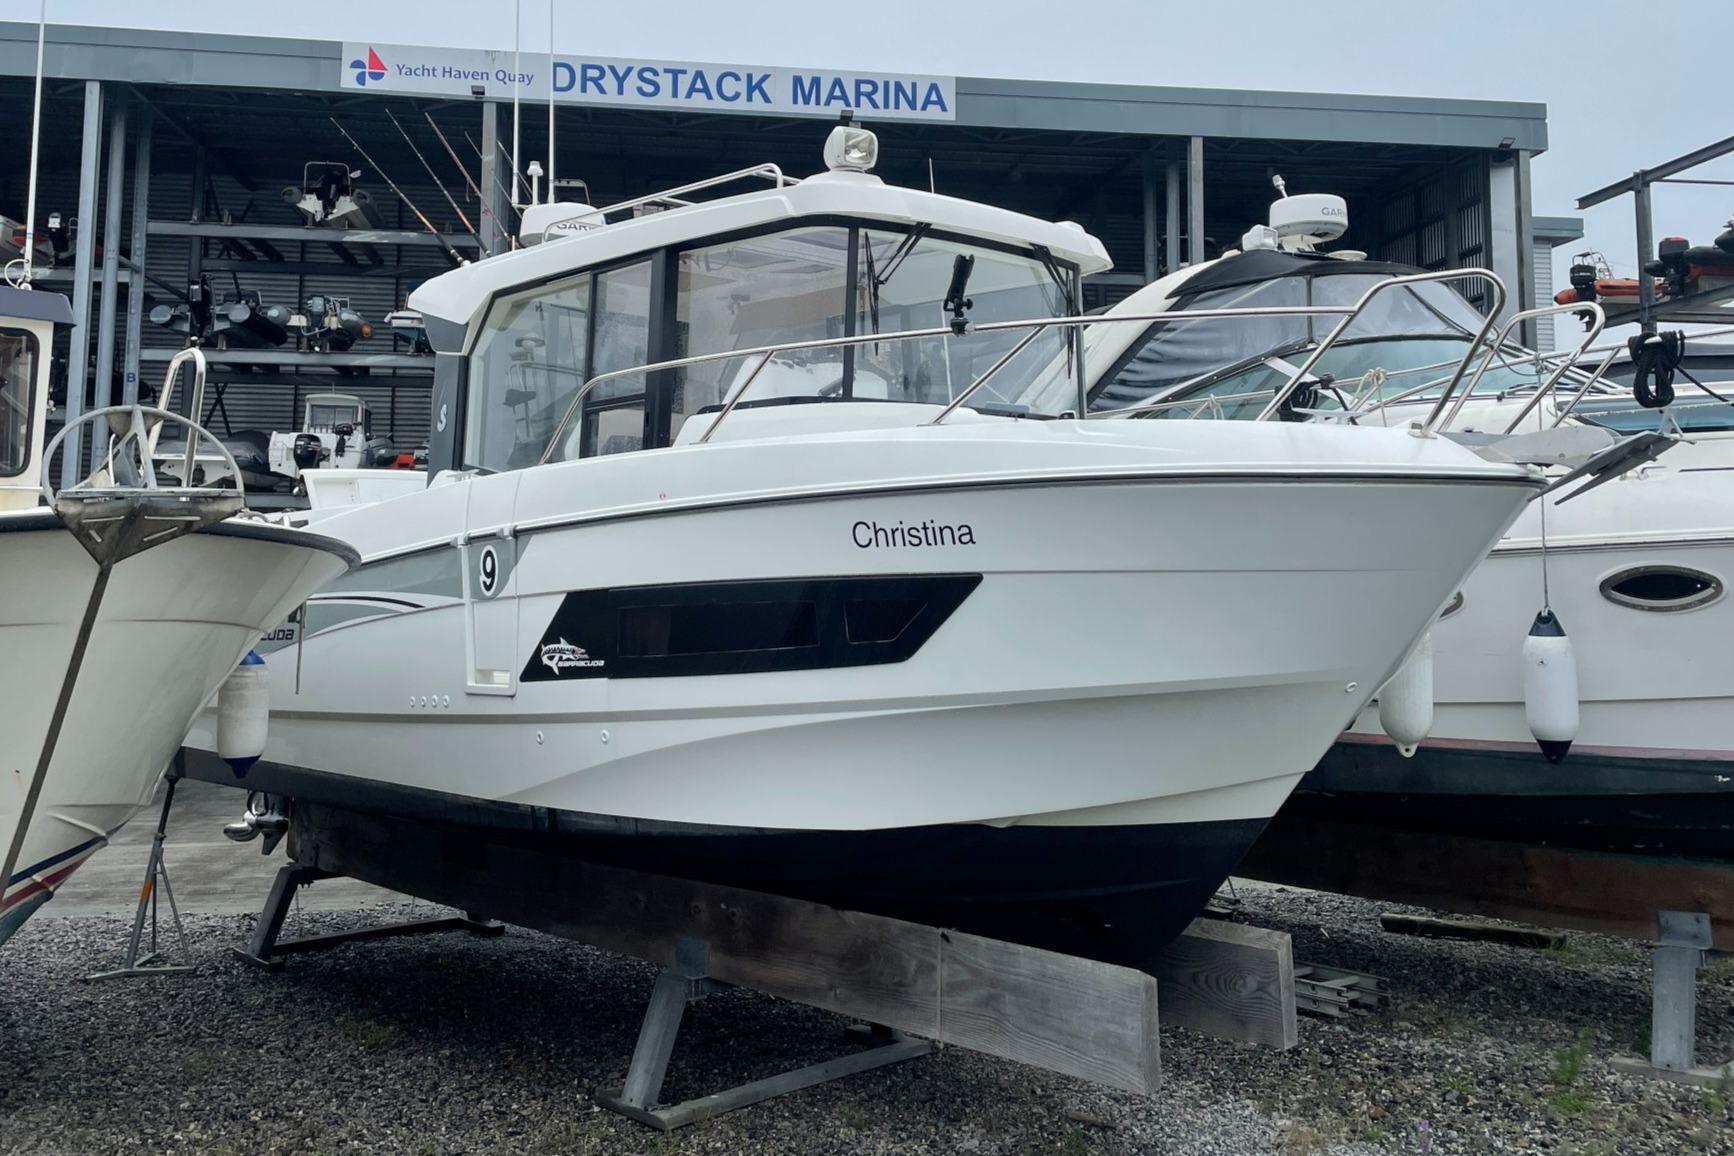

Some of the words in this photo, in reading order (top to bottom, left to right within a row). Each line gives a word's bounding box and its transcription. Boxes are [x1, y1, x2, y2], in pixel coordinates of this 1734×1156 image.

[396, 63, 437, 78] Yacht
[442, 66, 490, 82] Haven
[495, 69, 534, 86] Quay
[552, 62, 773, 104] DRYSTACK
[792, 75, 948, 113] MARINA
[852, 519, 976, 548] Christina
[482, 548, 497, 593] 9
